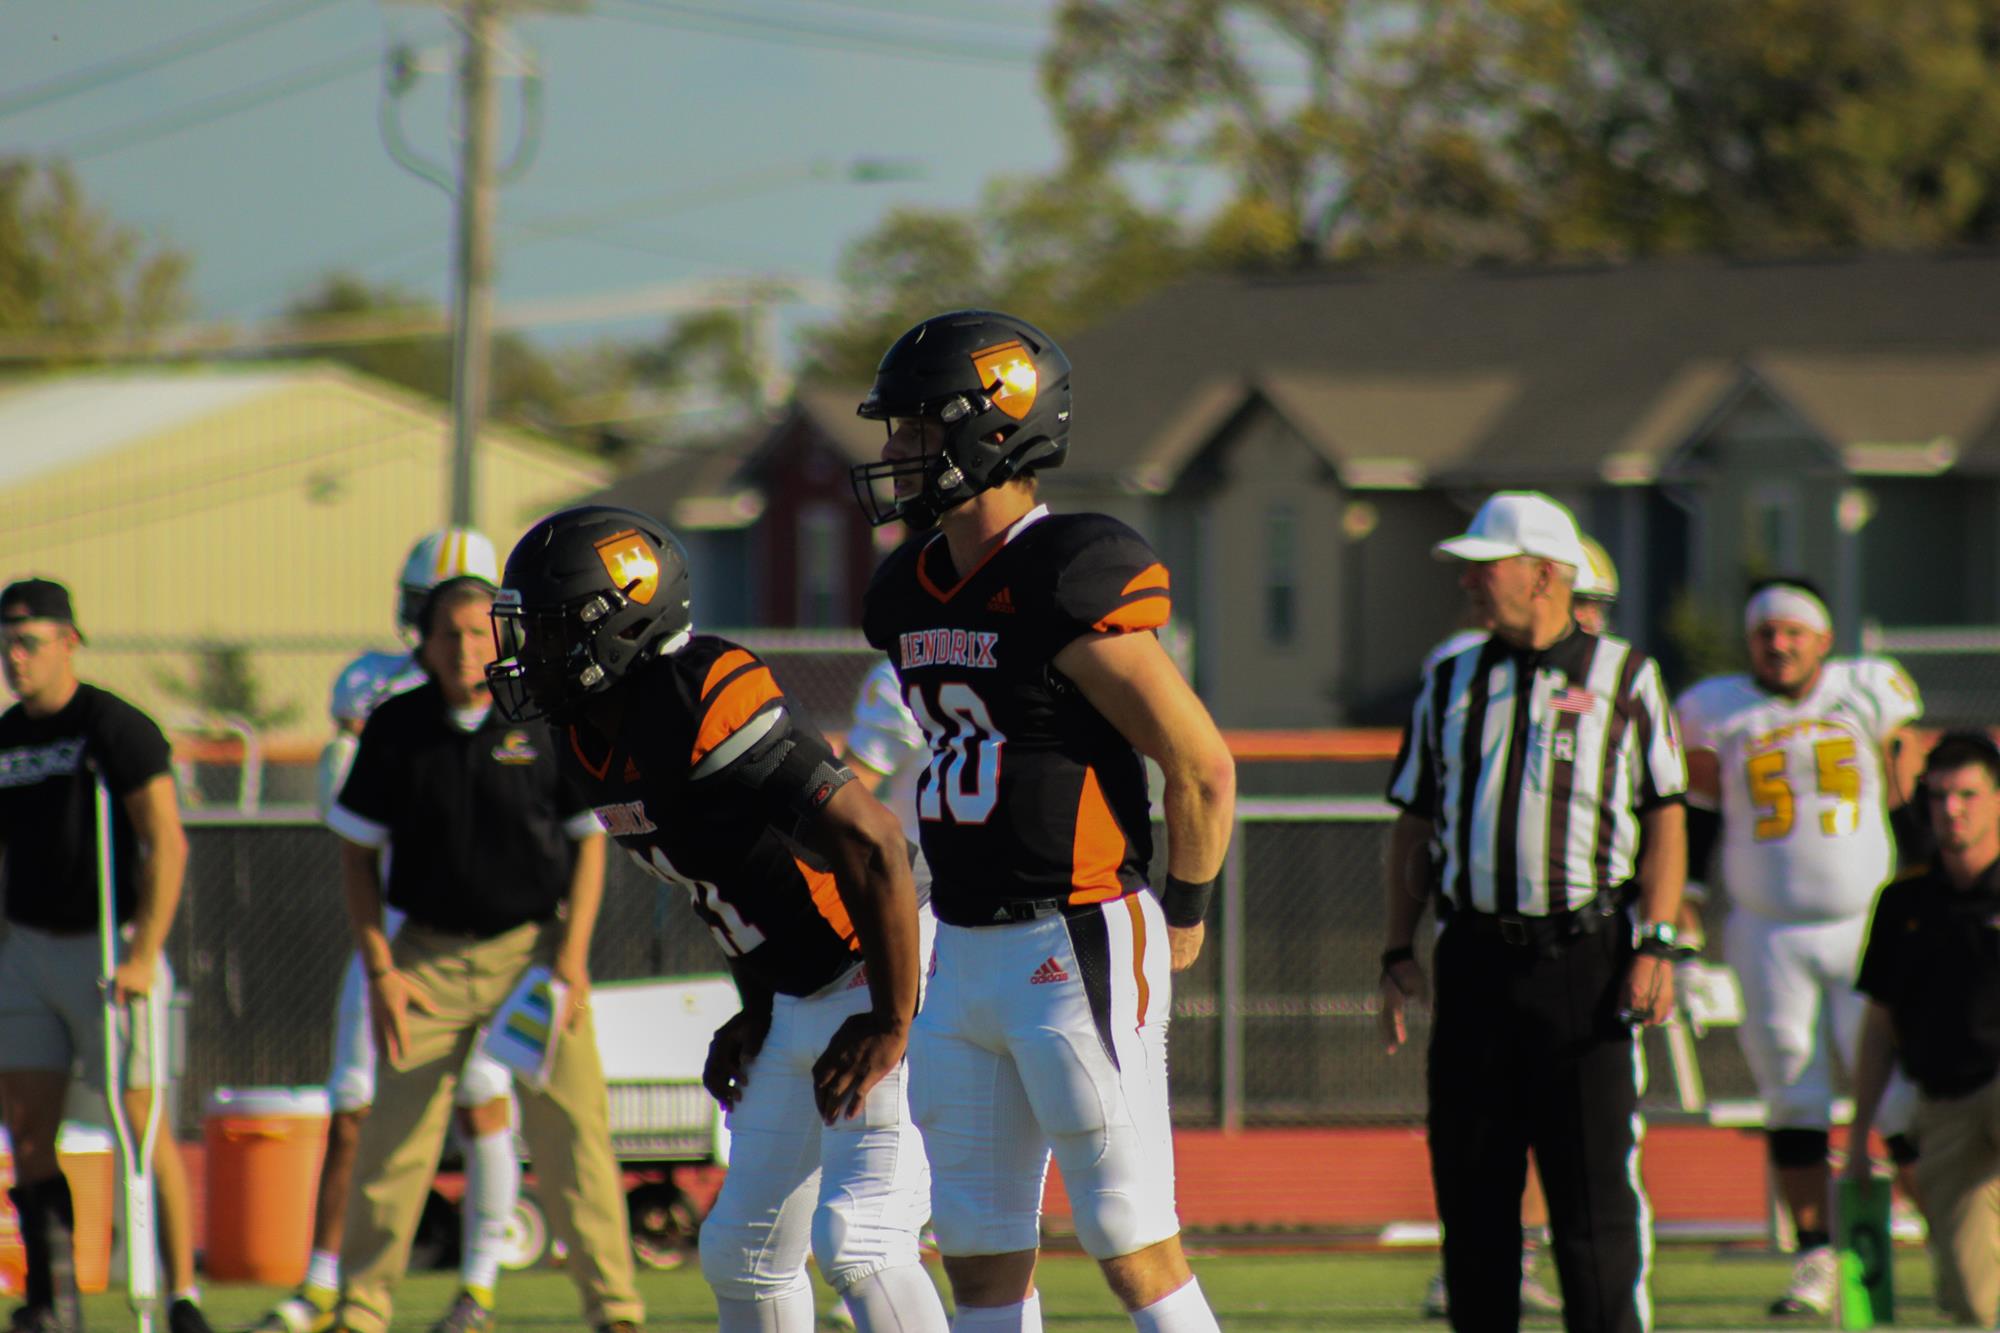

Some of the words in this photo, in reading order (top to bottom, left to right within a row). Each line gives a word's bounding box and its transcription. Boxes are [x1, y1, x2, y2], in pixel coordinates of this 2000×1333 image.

[899, 627, 998, 670] HENDRIX
[908, 682, 1006, 825] 10
[1554, 731, 1574, 762] R
[1746, 734, 1862, 843] 55
[1031, 971, 1069, 985] adidas
